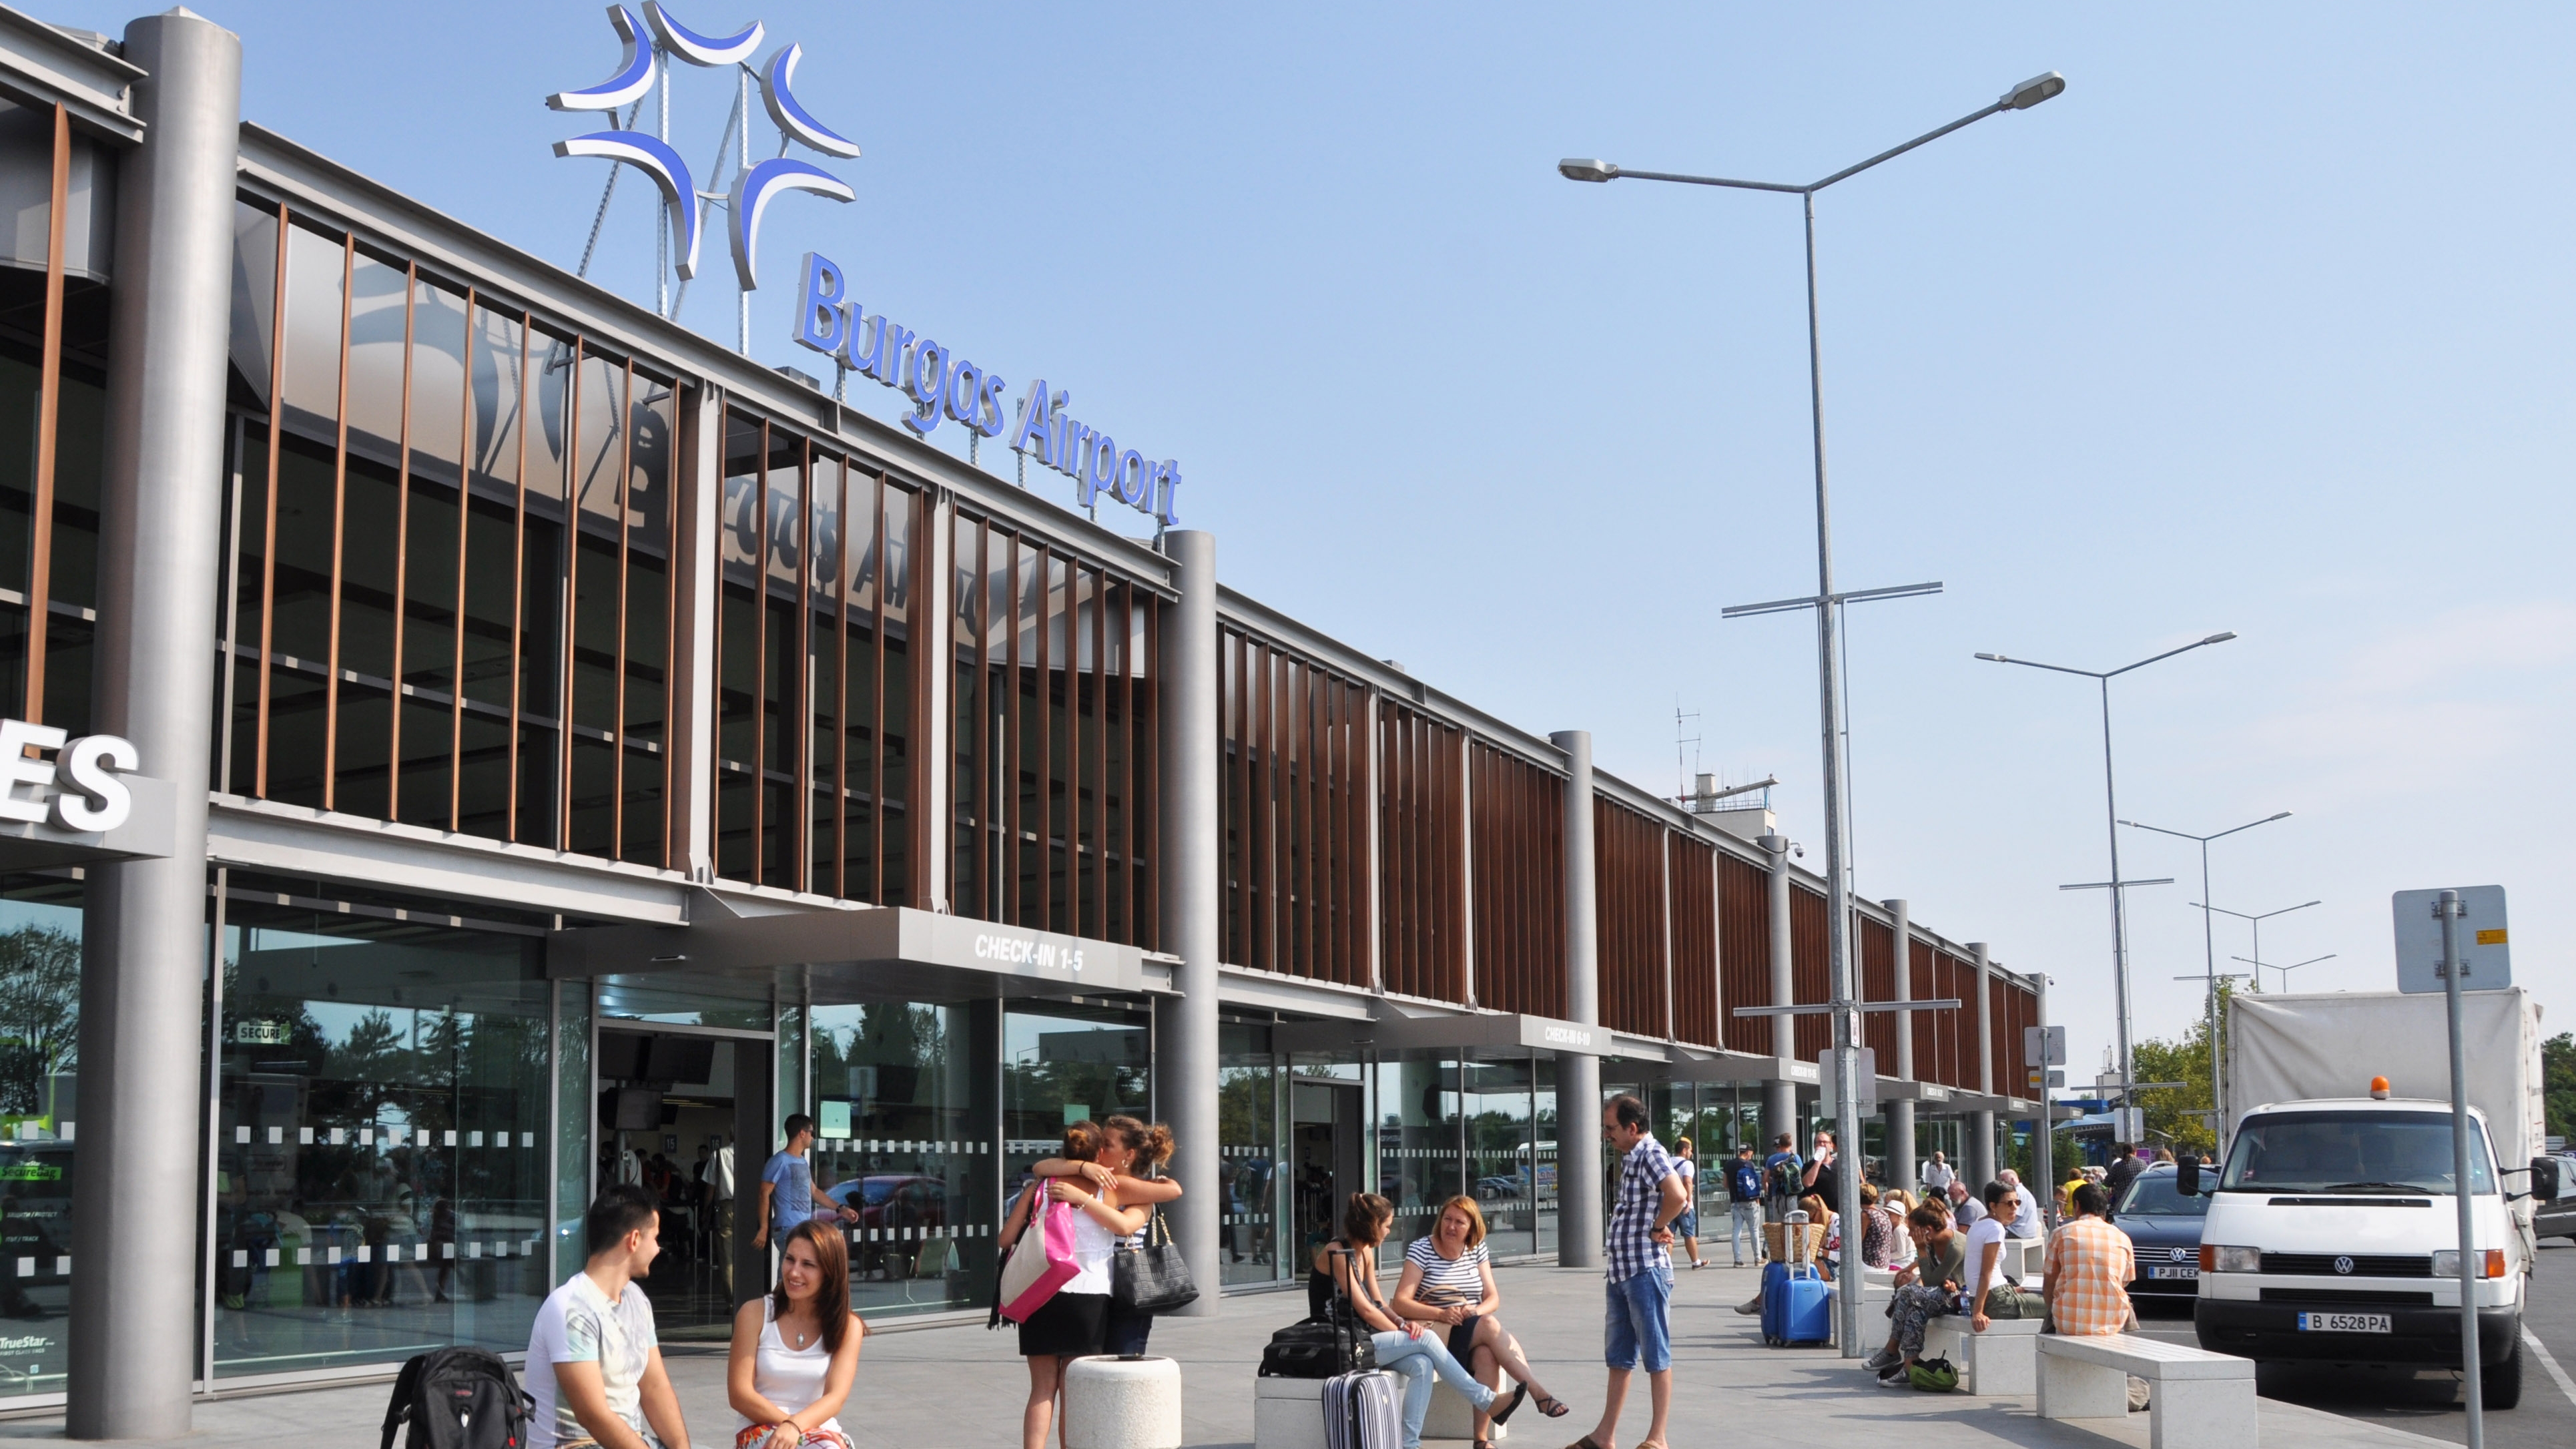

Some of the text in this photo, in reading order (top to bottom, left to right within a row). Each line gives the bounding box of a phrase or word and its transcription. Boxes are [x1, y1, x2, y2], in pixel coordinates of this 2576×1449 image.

[793, 252, 1181, 526] Burgas Airport
[975, 934, 1084, 972] CHECK-IN 1-5
[240, 1027, 280, 1039] SECURE
[1545, 1027, 1576, 1044] CHECK-IN
[667, 1138, 675, 1149] 15
[2, 1167, 56, 1179] SecureBag
[0, 1336, 47, 1349] TrueStar
